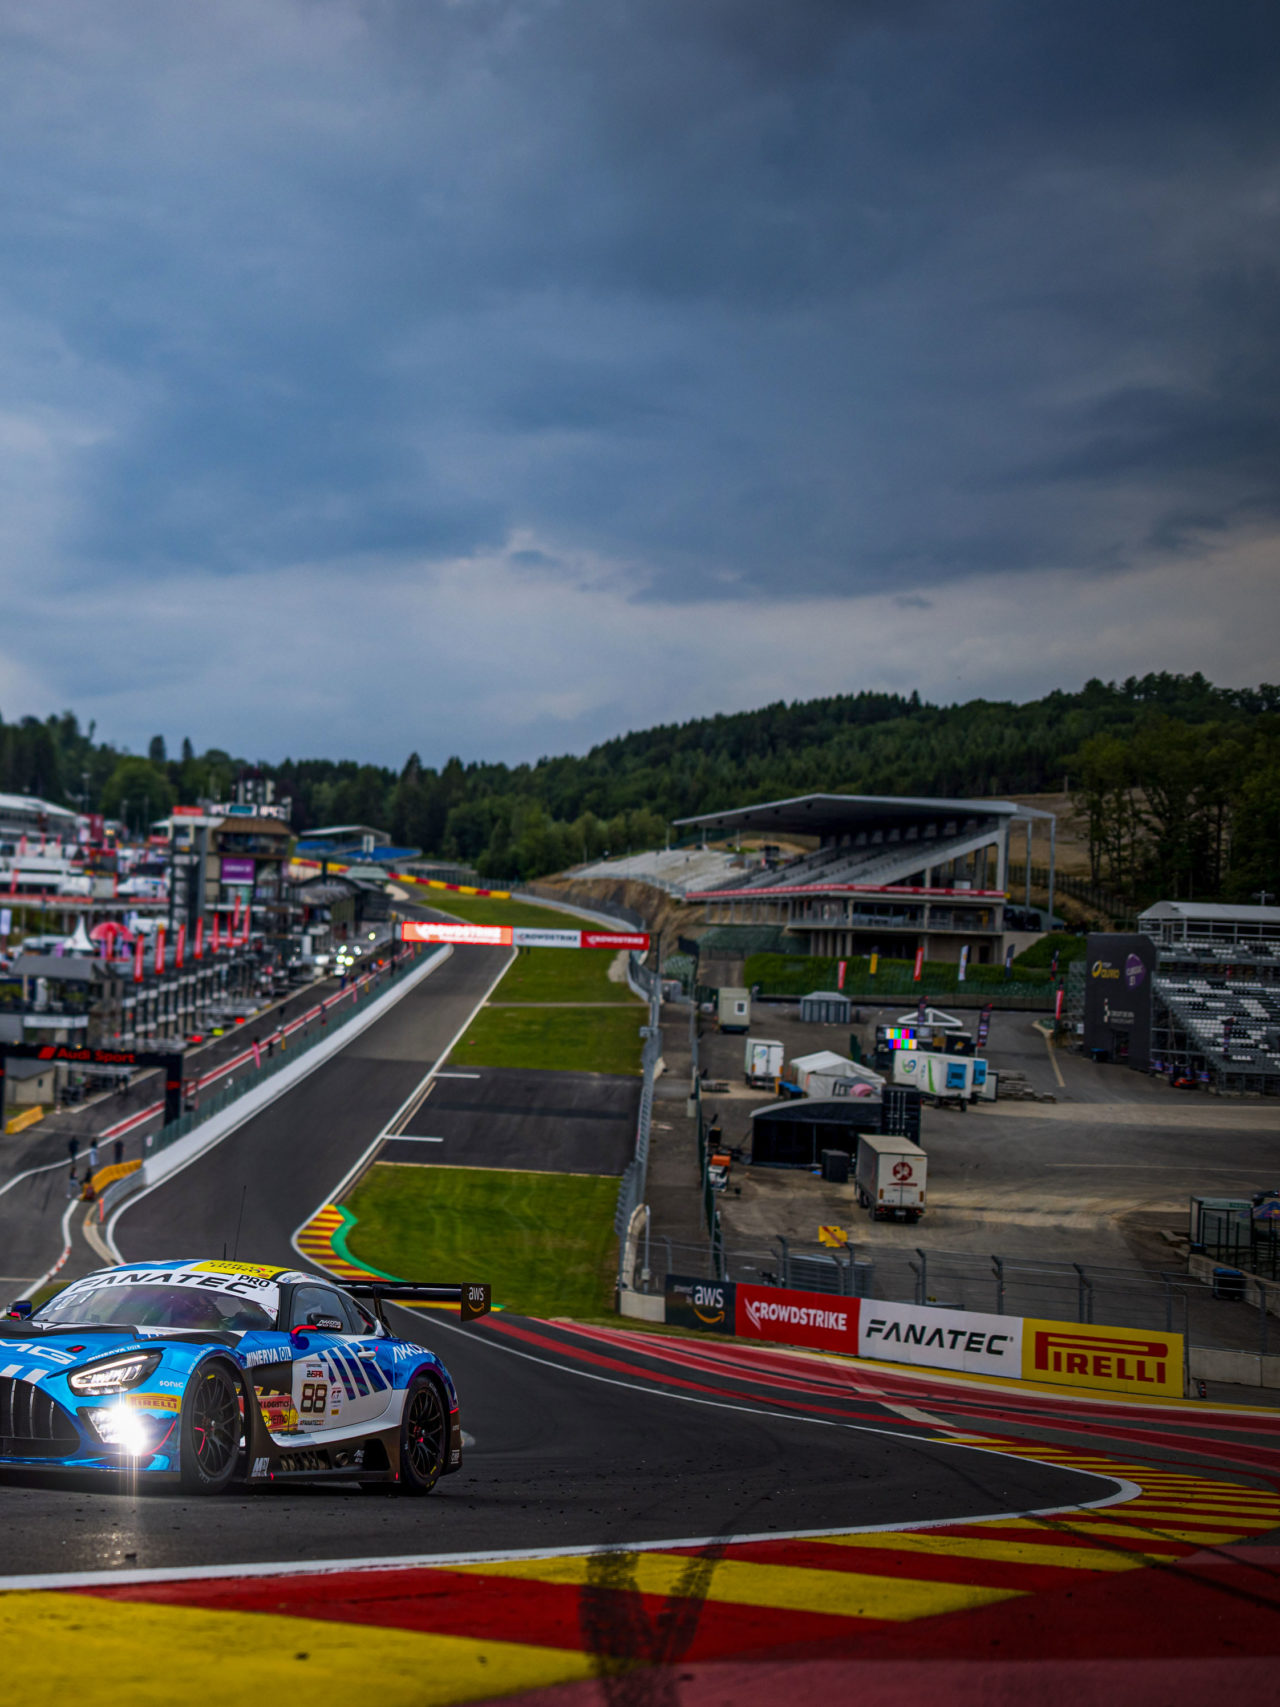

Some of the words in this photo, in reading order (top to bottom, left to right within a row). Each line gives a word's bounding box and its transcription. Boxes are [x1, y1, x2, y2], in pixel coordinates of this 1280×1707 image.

[520, 933, 578, 943] CROWDSTRIKE
[590, 935, 644, 945] CROWDSTRIKE
[57, 1048, 91, 1060] Audi
[94, 1050, 136, 1064] Sport
[73, 1273, 259, 1295] FANATEC
[238, 1275, 270, 1288] PRO
[469, 1287, 484, 1301] aws
[694, 1285, 724, 1308] aws
[751, 1300, 847, 1331] CROWDSTRIKE
[866, 1319, 1009, 1356] FANATEC
[246, 1348, 279, 1368] MINERVA
[1035, 1331, 1168, 1384] PIRELLI
[130, 1395, 177, 1409] PIRELLI
[301, 1383, 328, 1413] 88
